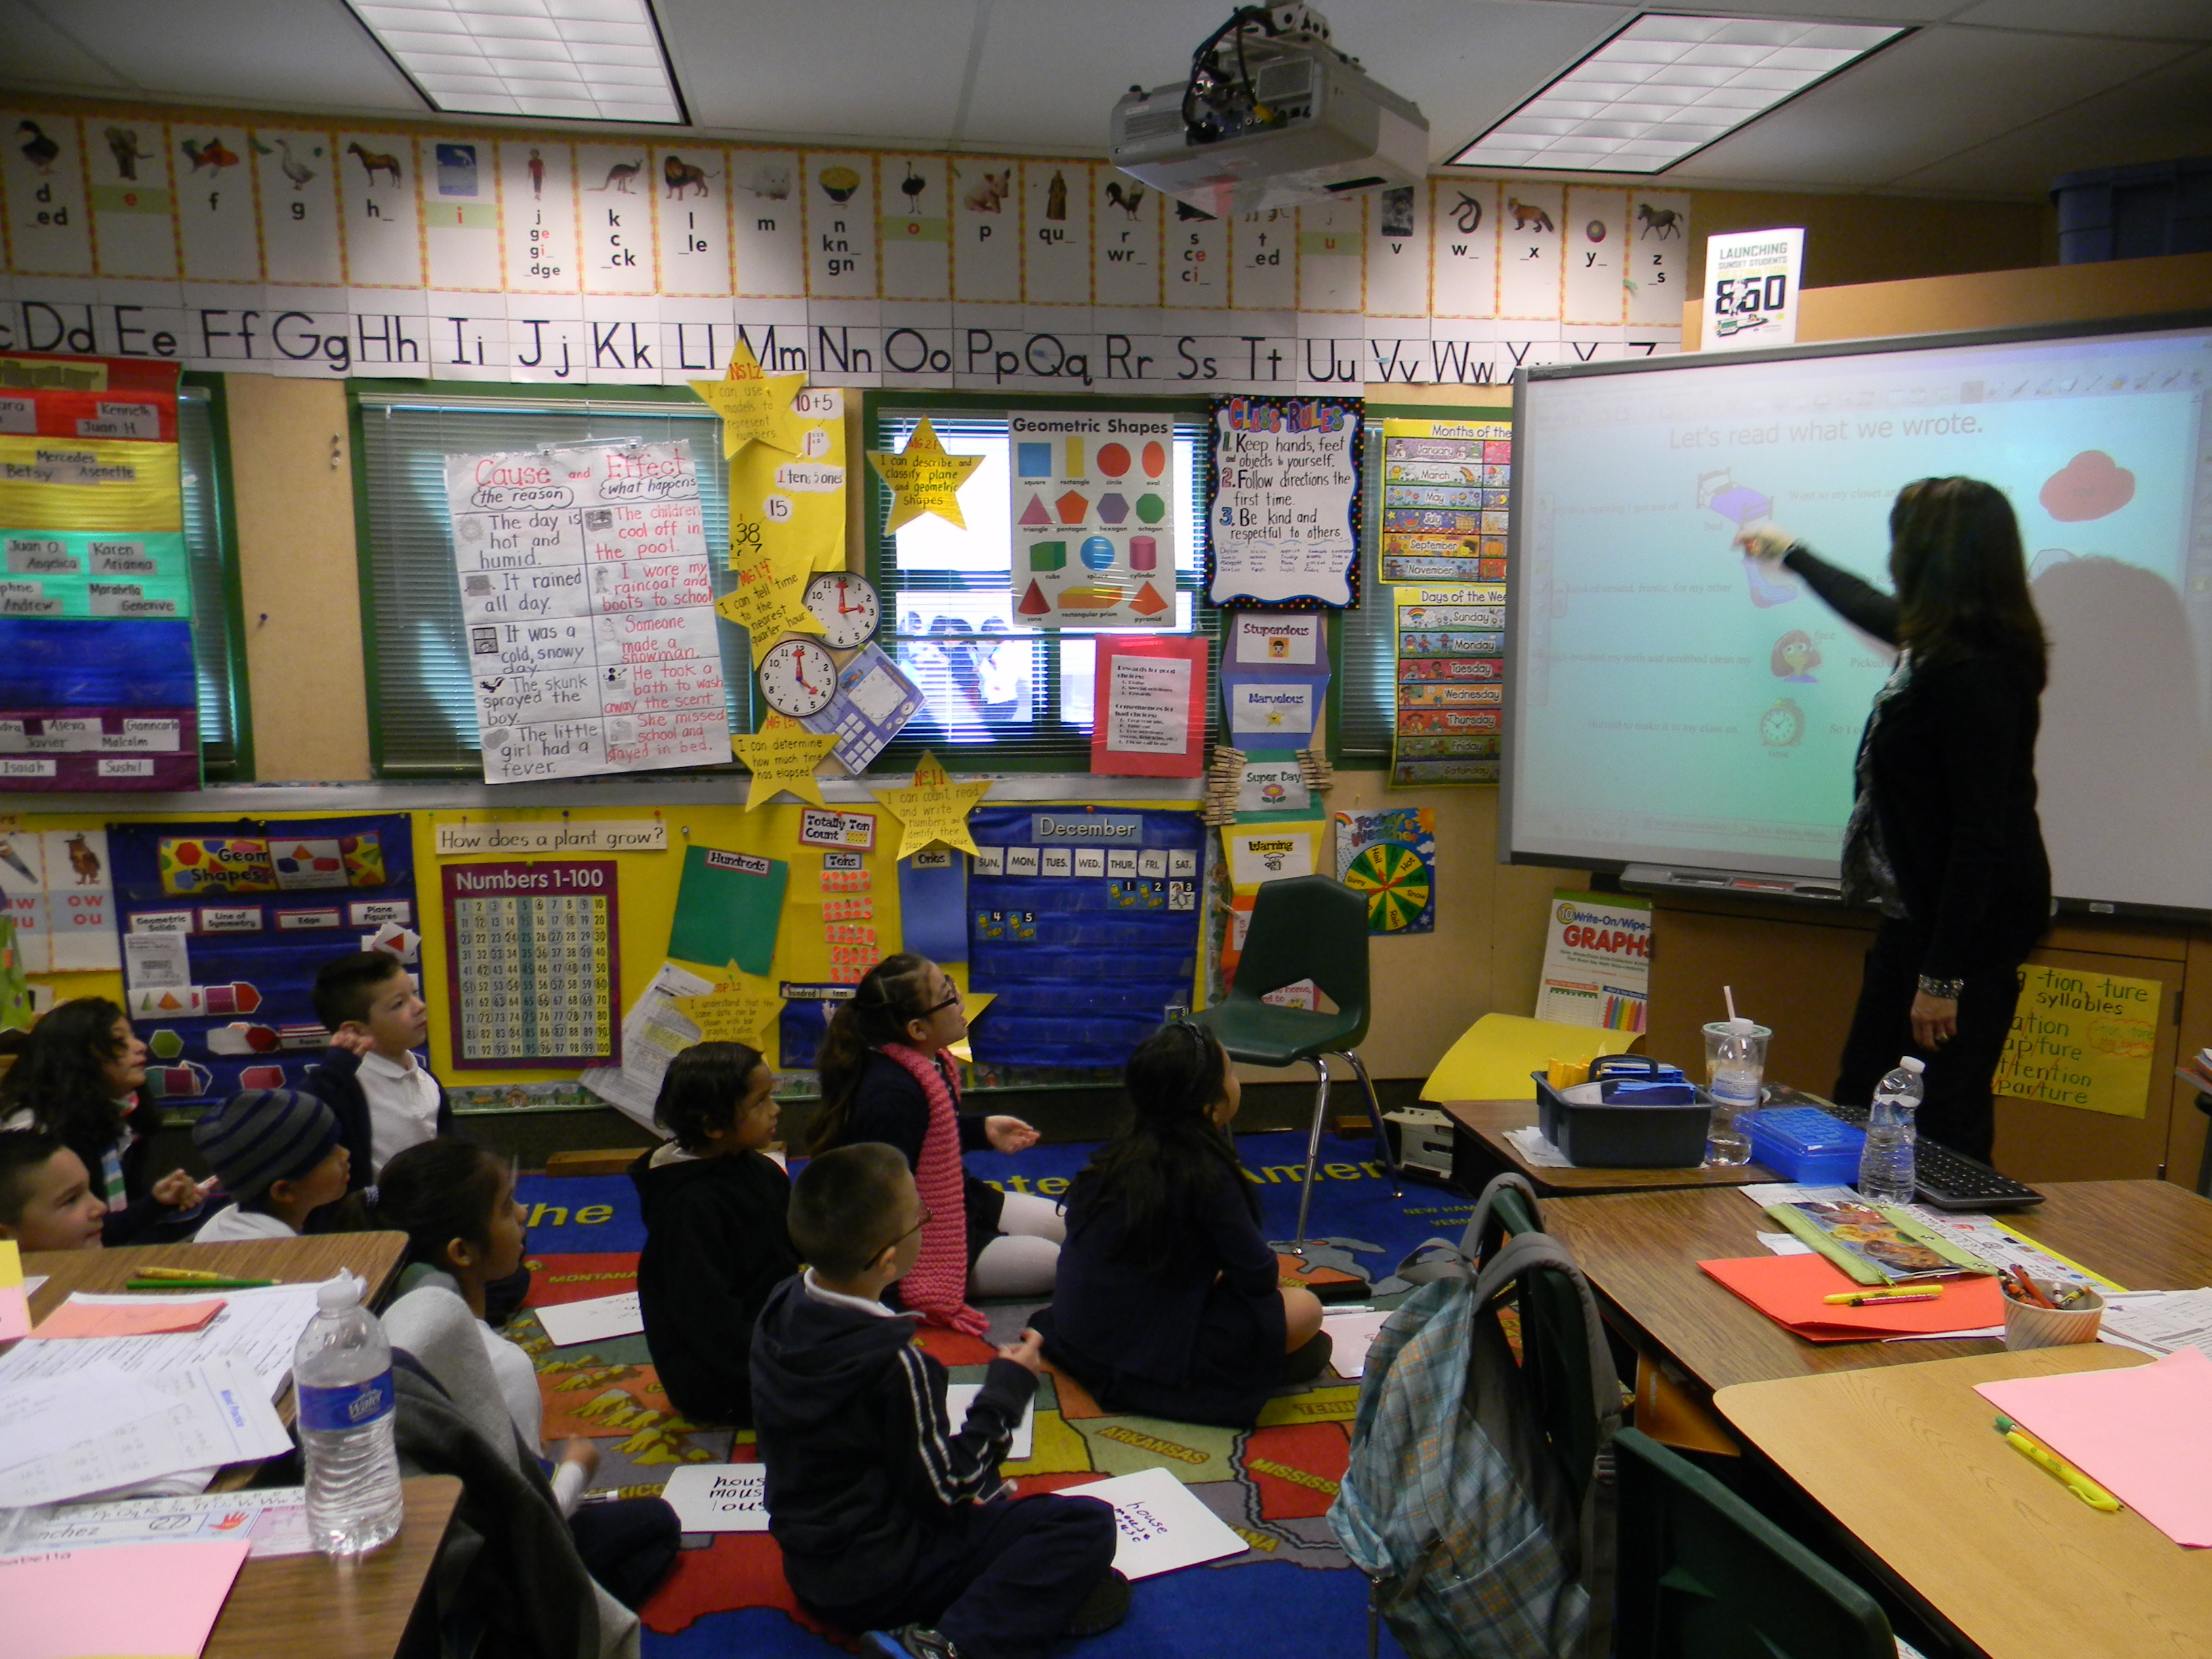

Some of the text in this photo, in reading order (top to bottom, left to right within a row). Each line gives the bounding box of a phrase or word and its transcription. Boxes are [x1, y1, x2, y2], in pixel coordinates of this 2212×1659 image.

[1720, 243, 1788, 259] LAUNCHING
[1719, 256, 1787, 270] SUNSET STUDENTS
[115, 306, 177, 356] Ee
[201, 310, 260, 359] Ff
[356, 314, 418, 363] Hh
[272, 312, 350, 371] Gg
[518, 320, 570, 377] Jj
[592, 322, 653, 369] Kk
[819, 326, 872, 373] Nn
[885, 328, 951, 373] Oo
[967, 329, 1019, 384] Pp
[1106, 334, 1153, 379] Rr
[1177, 337, 1217, 380] Ss
[1025, 334, 1092, 386] Qq
[1307, 339, 1355, 382] Uu
[1432, 342, 1494, 382] Ww
[1229, 398, 1343, 434] CLASS RULES
[1013, 418, 1168, 435] Geometric Shapes
[1432, 426, 1511, 437] Months of the
[1670, 413, 1983, 450] Let's read what we wrote.
[1223, 432, 1345, 457] 1. Keep hands, feet
[1417, 445, 1454, 457] January
[37, 450, 95, 463] Mercedes
[881, 455, 885, 465] I
[913, 456, 951, 468] describe
[959, 457, 972, 466] and
[1226, 455, 1334, 472] and objects to yourself.
[475, 449, 687, 487] Cause and Effect
[886, 468, 958, 483] classify plane
[1421, 470, 1450, 480] March
[609, 478, 695, 495] what happens
[1221, 468, 1351, 489] 2. Follow directions the
[480, 489, 562, 504] the reason
[904, 496, 943, 508] shapes
[1233, 493, 1294, 506] first time.
[1425, 493, 1444, 504] May
[615, 504, 700, 520] The children
[1220, 507, 1317, 527] 3. Be kind and
[1424, 513, 1441, 526] July
[489, 511, 581, 531] The day is
[619, 521, 699, 539] cool off in
[1231, 527, 1282, 545] respectful
[1290, 527, 1299, 537] to
[490, 532, 559, 549] hot and
[1410, 540, 1458, 551] September
[94, 544, 134, 556] Karen
[480, 548, 541, 569] humid.
[596, 541, 679, 560] the pool.
[504, 568, 581, 590] It rained
[621, 563, 705, 579] I wore my
[1408, 565, 1454, 576] November
[615, 575, 708, 595] raincoat and
[485, 594, 550, 613] all day.
[603, 595, 642, 611] boots
[655, 592, 667, 605] to
[1422, 590, 1485, 602] Days of the
[1454, 613, 1489, 623] Sunday
[1244, 623, 1309, 636] Stupendous
[1454, 639, 1494, 652] Monday
[1450, 663, 1491, 676] Tuesday
[1249, 693, 1303, 703] Marvelous
[1443, 689, 1500, 701] Wednesday
[1447, 714, 1496, 726] Thursday
[1247, 773, 1300, 783] Super Day
[807, 815, 870, 831] Totally Ten
[1040, 817, 1136, 836] December
[442, 828, 663, 849] How does a plant grow?
[806, 828, 839, 840] Count
[1249, 840, 1293, 851] Warning
[711, 853, 766, 872] Hundreds
[830, 855, 856, 866] Tens
[979, 857, 1191, 869] SUN. MON. TUES. WED. THUR. FRI. SAT.
[1372, 848, 1382, 863] Hail
[1401, 857, 1415, 871] Hot
[191, 868, 262, 882] Shapes
[456, 869, 603, 890] Numbers 1-100
[2036, 993, 2123, 1015] syllables
[548, 1271, 638, 1283] MONTANA
[1094, 1426, 1210, 1464] ARKANSAS
[1126, 1502, 1167, 1534] house
